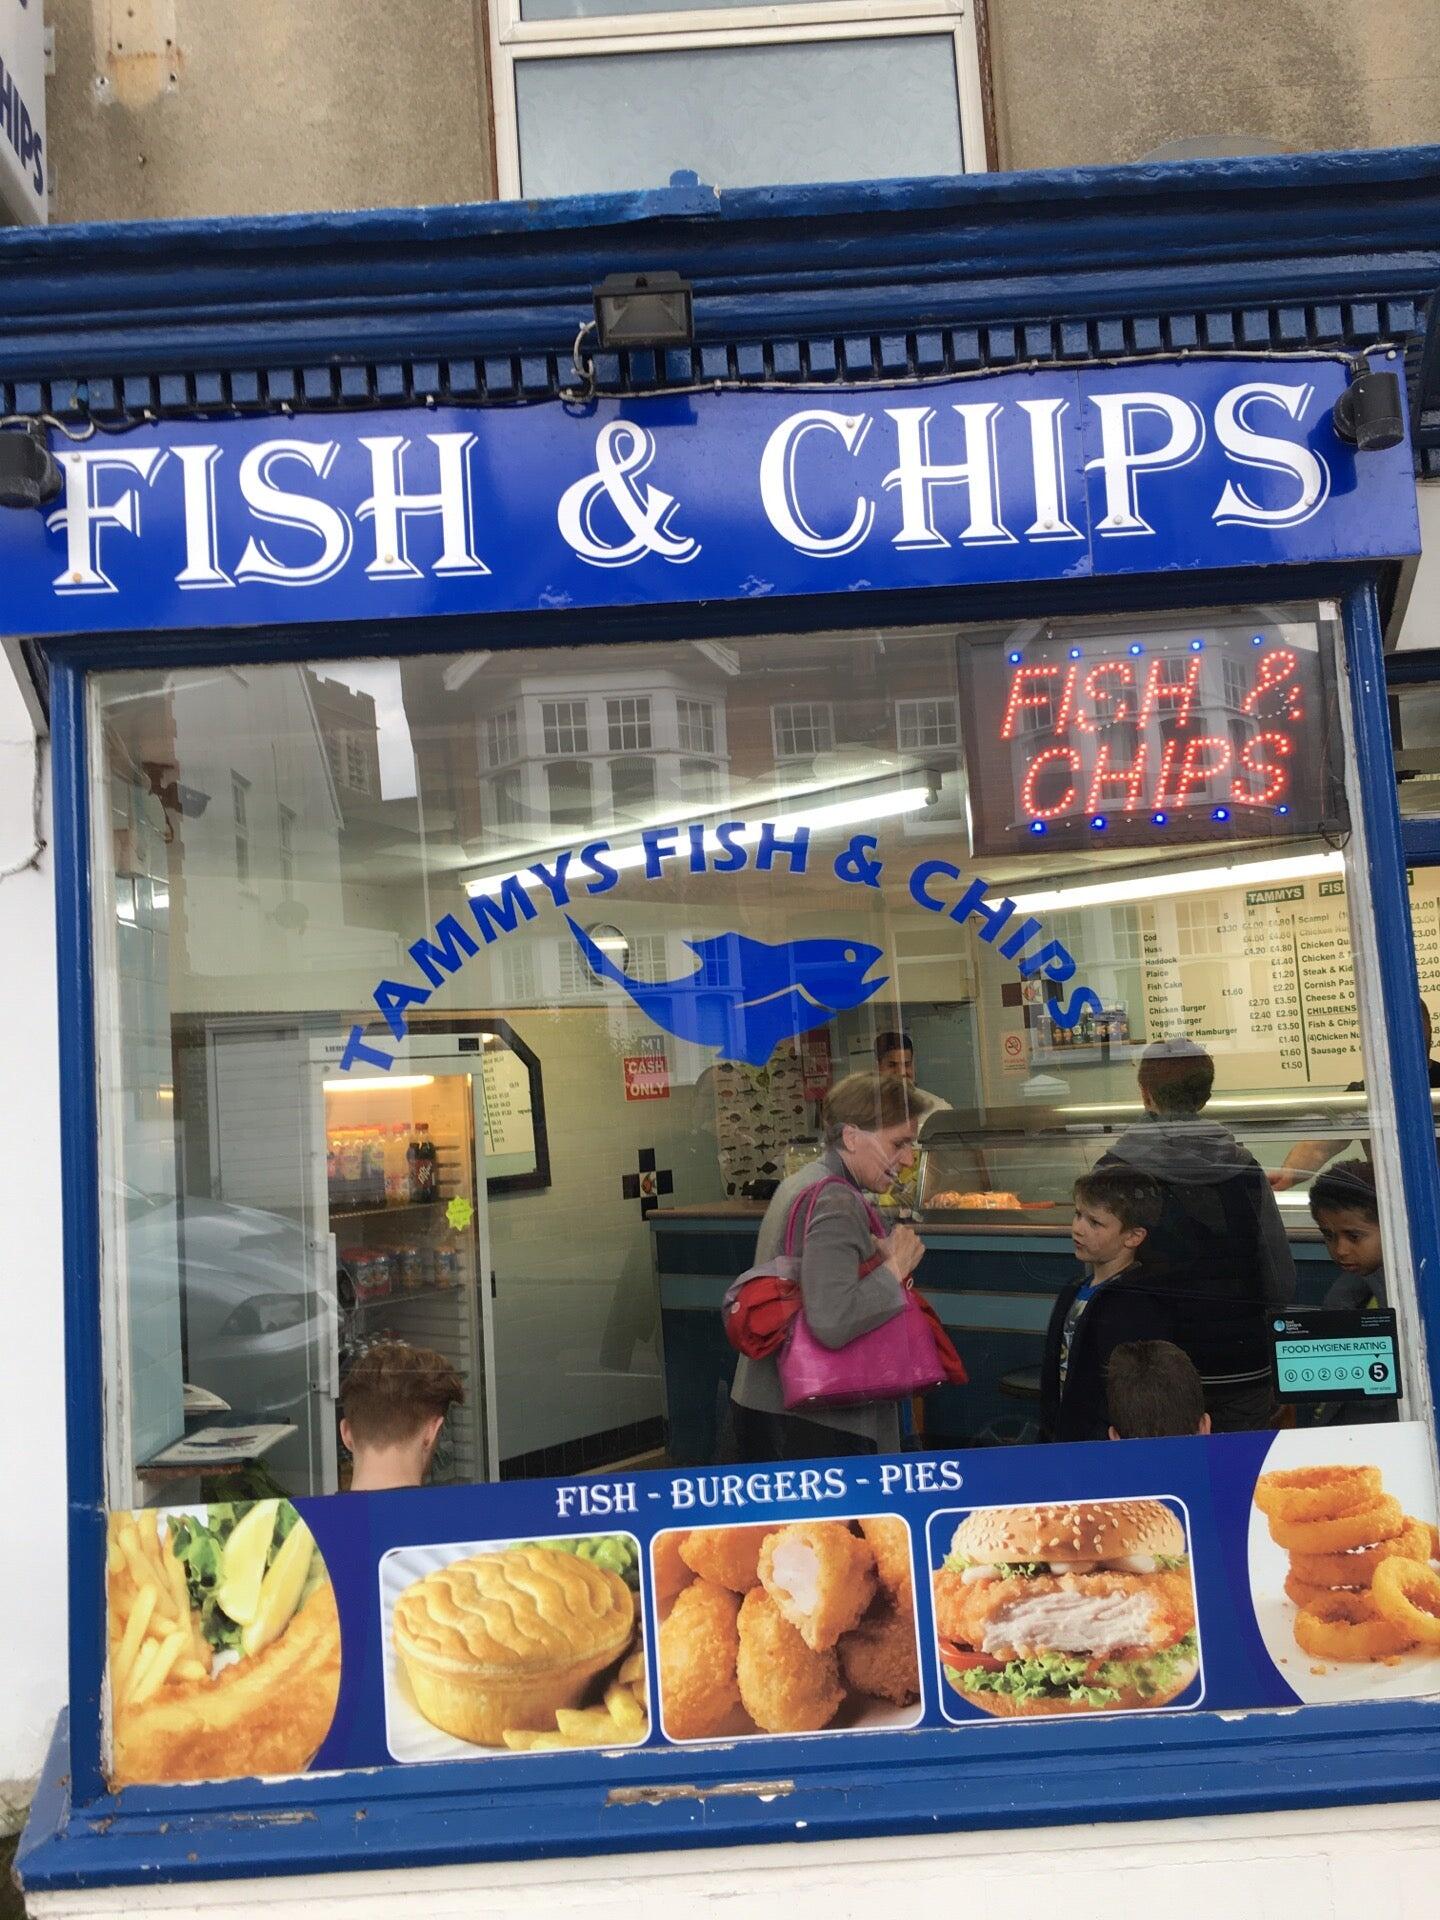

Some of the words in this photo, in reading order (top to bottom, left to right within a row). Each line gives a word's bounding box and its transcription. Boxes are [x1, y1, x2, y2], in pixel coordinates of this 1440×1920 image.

[46, 432, 492, 596] FISH
[557, 419, 702, 569] &
[759, 382, 1331, 559] CHIPS
[1001, 653, 1202, 740] FISH
[1020, 729, 1293, 819] CHIPS
[1248, 887, 1302, 904] TAMMYS
[1143, 934, 1157, 942] Cod
[339, 840, 620, 1073] TAMMYS
[641, 822, 811, 881] FISH
[834, 834, 884, 889] &
[908, 859, 1104, 1030] CHIPS
[1300, 940, 1335, 950] Chicken
[1145, 957, 1177, 966] Haddock
[1301, 953, 1336, 963] Chicken
[1146, 970, 1169, 978] Plaice
[1303, 967, 1327, 976] Steak
[1147, 982, 1162, 990] Fish
[1304, 980, 1337, 989] Cornish
[1148, 995, 1169, 1003] Chips
[1305, 993, 1337, 1002] Cheese
[1149, 1006, 1179, 1015] Chicken
[1180, 1005, 1206, 1013] Burger
[1274, 996, 1297, 1004] £3.50
[1306, 1004, 1357, 1015] CHILDRENS
[1150, 1019, 1175, 1028] Veggie
[1177, 1017, 1203, 1026] Burger
[1249, 1011, 1271, 1019] £2.40
[1276, 1009, 1298, 1017] £2.90
[1164, 1030, 1194, 1038] Pounder
[1195, 1027, 1238, 1037] Hamburger
[1277, 1022, 1300, 1031] £3.50
[1310, 1046, 1347, 1055] Sausage
[628, 1060, 665, 1074] CASH
[1281, 1061, 1303, 1070] £1.50
[630, 1081, 666, 1097] ONLY
[1282, 1344, 1311, 1354] FOOD
[1312, 1343, 1352, 1352] HYGIENE
[1353, 1341, 1387, 1351] RATING
[556, 1482, 639, 1518] FISH
[670, 1467, 848, 1510] BURGERS
[879, 1460, 964, 1495] PIES
